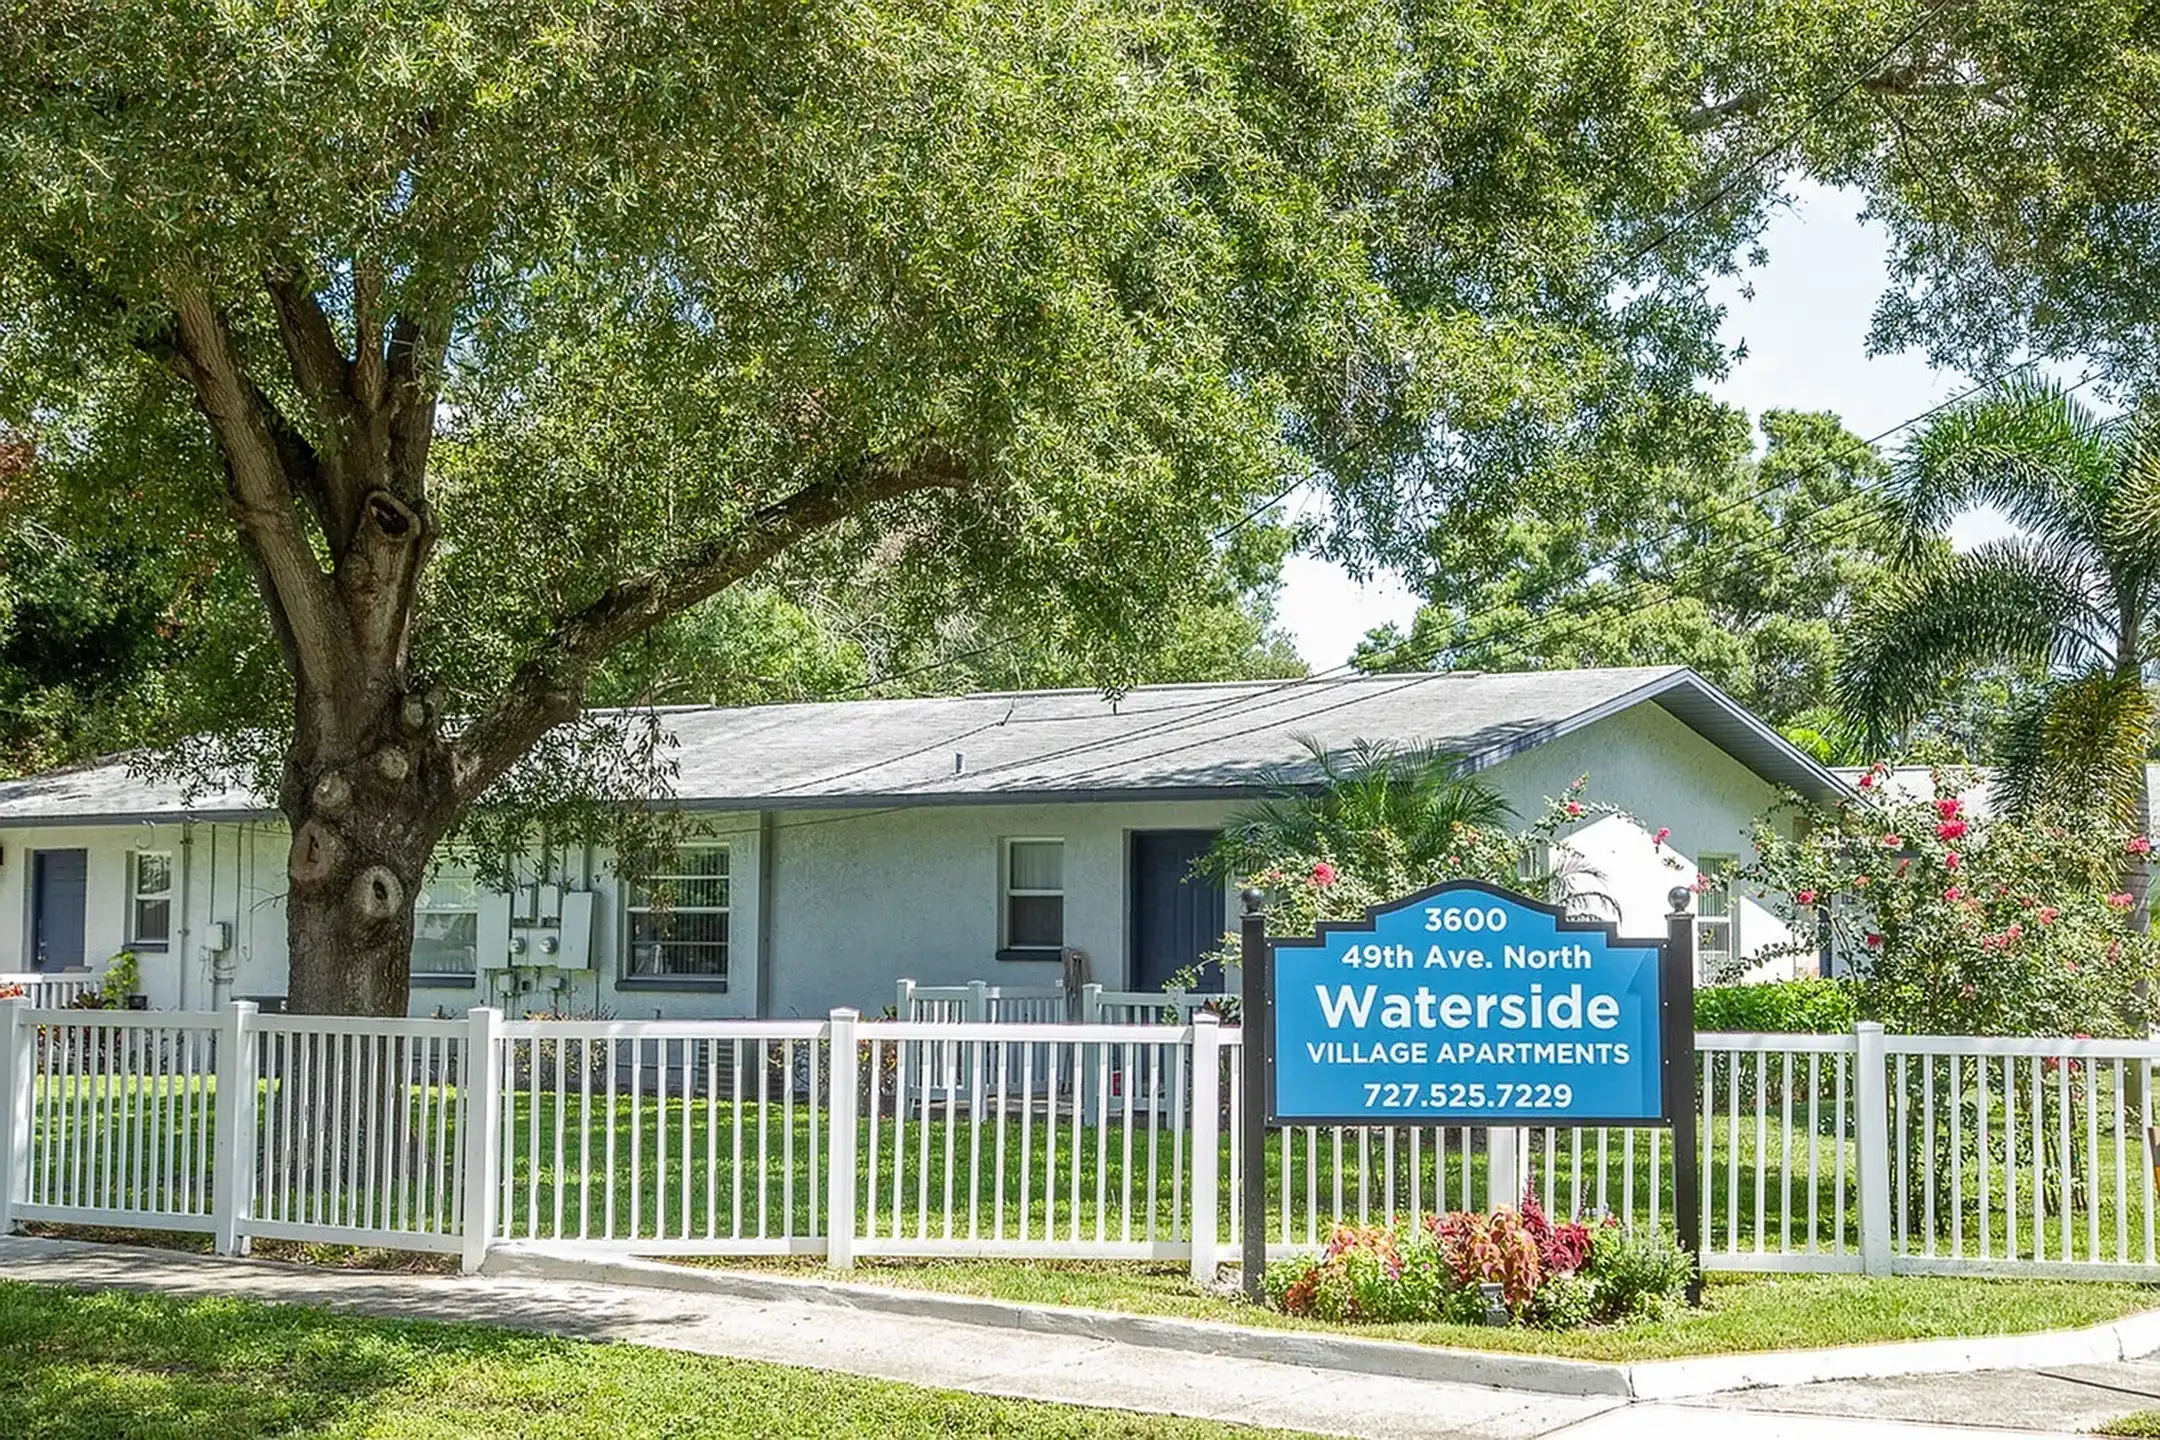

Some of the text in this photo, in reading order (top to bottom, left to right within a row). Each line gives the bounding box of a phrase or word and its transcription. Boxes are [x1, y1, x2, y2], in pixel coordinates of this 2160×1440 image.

[1424, 907, 1507, 932] 3600
[1341, 944, 1591, 969] 49th Ave. North
[1315, 983, 1620, 1029] Waterside
[1306, 1042, 1630, 1065] VILLAGE APARTMENTS
[1364, 1083, 1572, 1108] 727.525.7229
